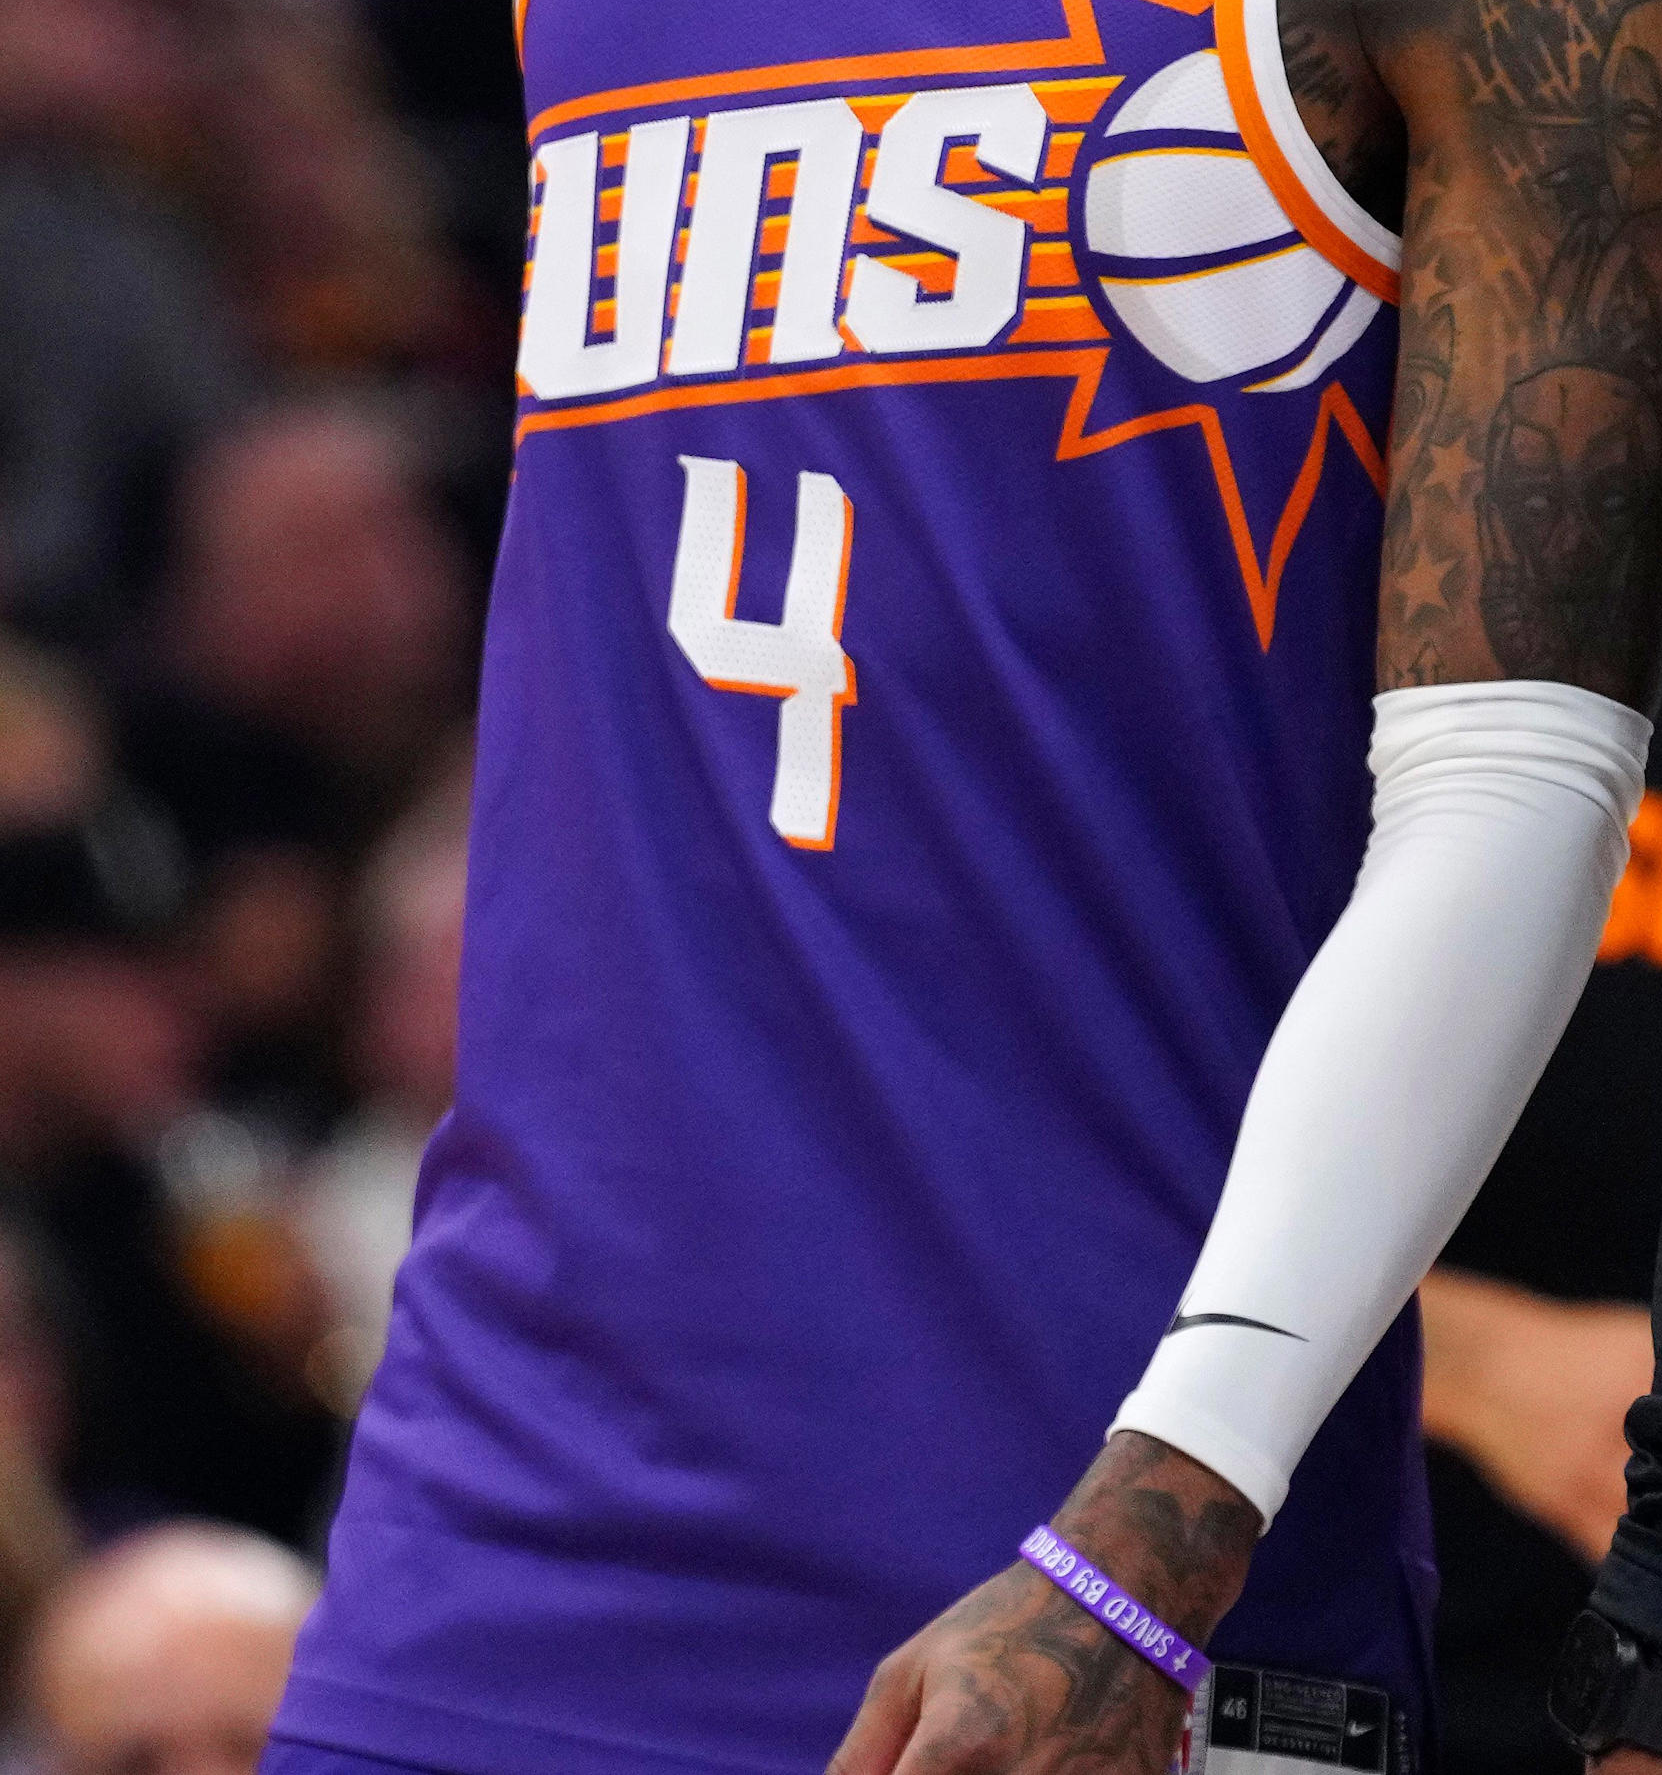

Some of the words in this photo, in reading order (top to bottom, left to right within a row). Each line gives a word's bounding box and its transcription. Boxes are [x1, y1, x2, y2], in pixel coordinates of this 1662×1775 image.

[517, 80, 1051, 401] UNS
[667, 455, 857, 852] 4
[1071, 1567, 1110, 1604] BY
[1103, 1590, 1175, 1659] SAVED
[1223, 1697, 1249, 1720] 46
